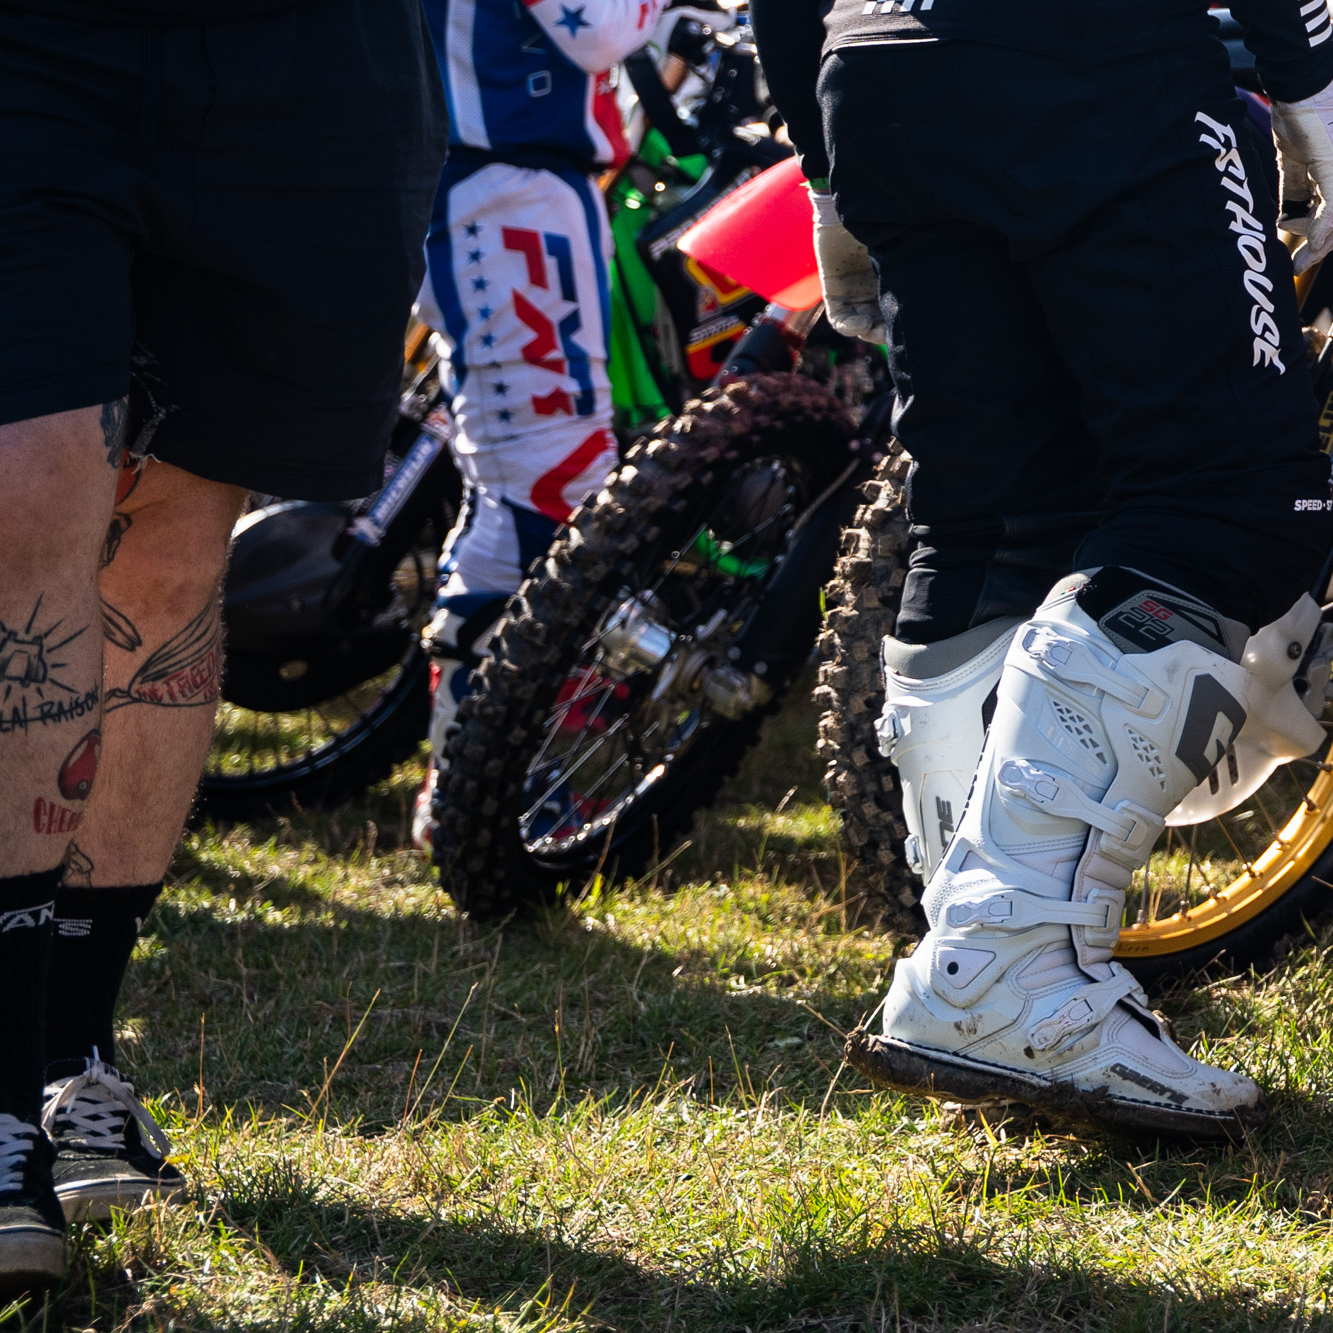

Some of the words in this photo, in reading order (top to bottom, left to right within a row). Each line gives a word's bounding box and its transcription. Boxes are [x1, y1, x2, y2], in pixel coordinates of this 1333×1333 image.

[1294, 498, 1325, 511] SPEED
[1138, 599, 1175, 621] SG
[1118, 606, 1175, 641] 22
